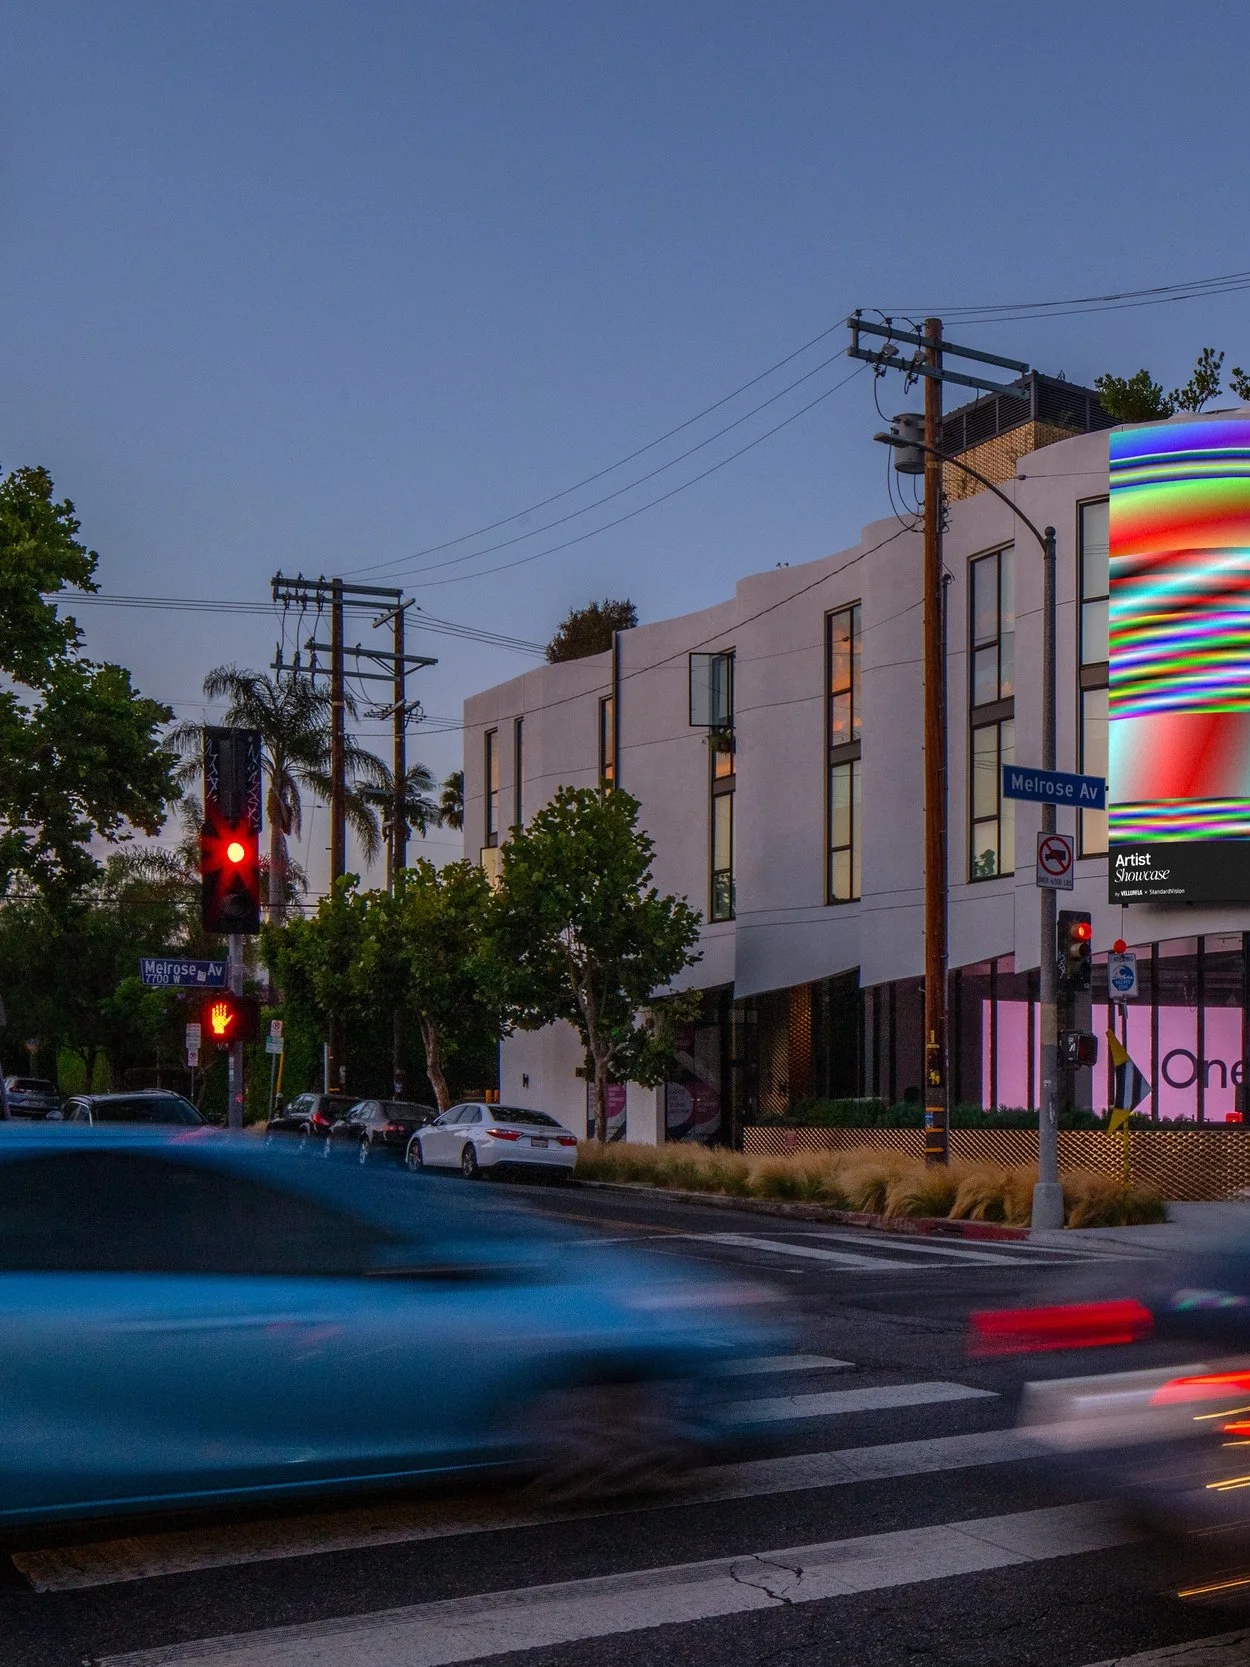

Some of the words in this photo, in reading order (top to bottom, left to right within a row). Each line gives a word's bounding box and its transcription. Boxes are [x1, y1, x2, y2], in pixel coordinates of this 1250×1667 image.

[1011, 773, 1074, 797] Melrose
[1079, 782, 1098, 800] Av
[1115, 852, 1151, 868] Artist
[1114, 867, 1171, 884] Showcase
[145, 960, 197, 976] Melrose
[207, 963, 223, 977] Av
[145, 973, 169, 984] 7700
[173, 974, 181, 984] W
